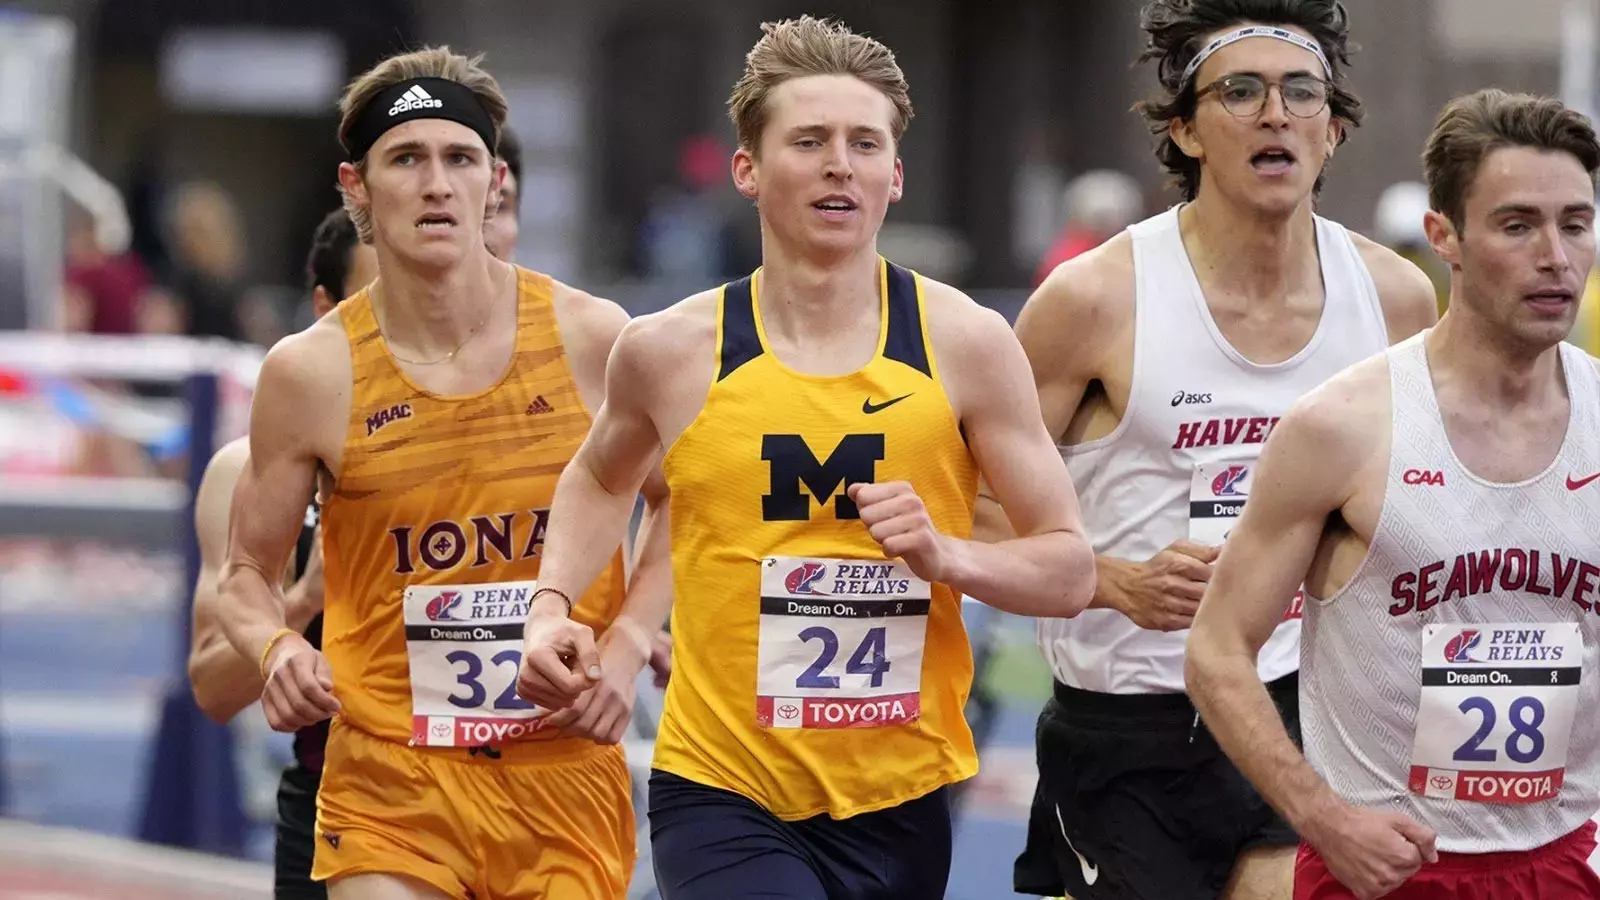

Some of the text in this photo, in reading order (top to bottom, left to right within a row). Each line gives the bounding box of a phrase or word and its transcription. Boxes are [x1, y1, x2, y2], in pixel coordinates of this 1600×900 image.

[388, 99, 443, 116] adidas
[1185, 393, 1212, 404] asics
[365, 403, 414, 437] MAAC
[761, 433, 885, 521] M
[1403, 469, 1446, 486] CAA
[1213, 503, 1243, 515] Drea
[835, 564, 895, 579] PENN
[832, 579, 910, 594] RELAYS
[472, 588, 528, 604] PENN
[787, 601, 857, 616] Dream On.
[430, 628, 497, 640] Dream On.
[1490, 630, 1546, 645] PENN
[796, 626, 891, 689] 24
[1487, 646, 1564, 661] RELAYS
[445, 650, 536, 709] 32
[1446, 671, 1512, 684] Dream On.
[809, 700, 906, 723] TOYOTA
[1453, 696, 1545, 764] 28
[1463, 776, 1551, 798] TOYOTA
